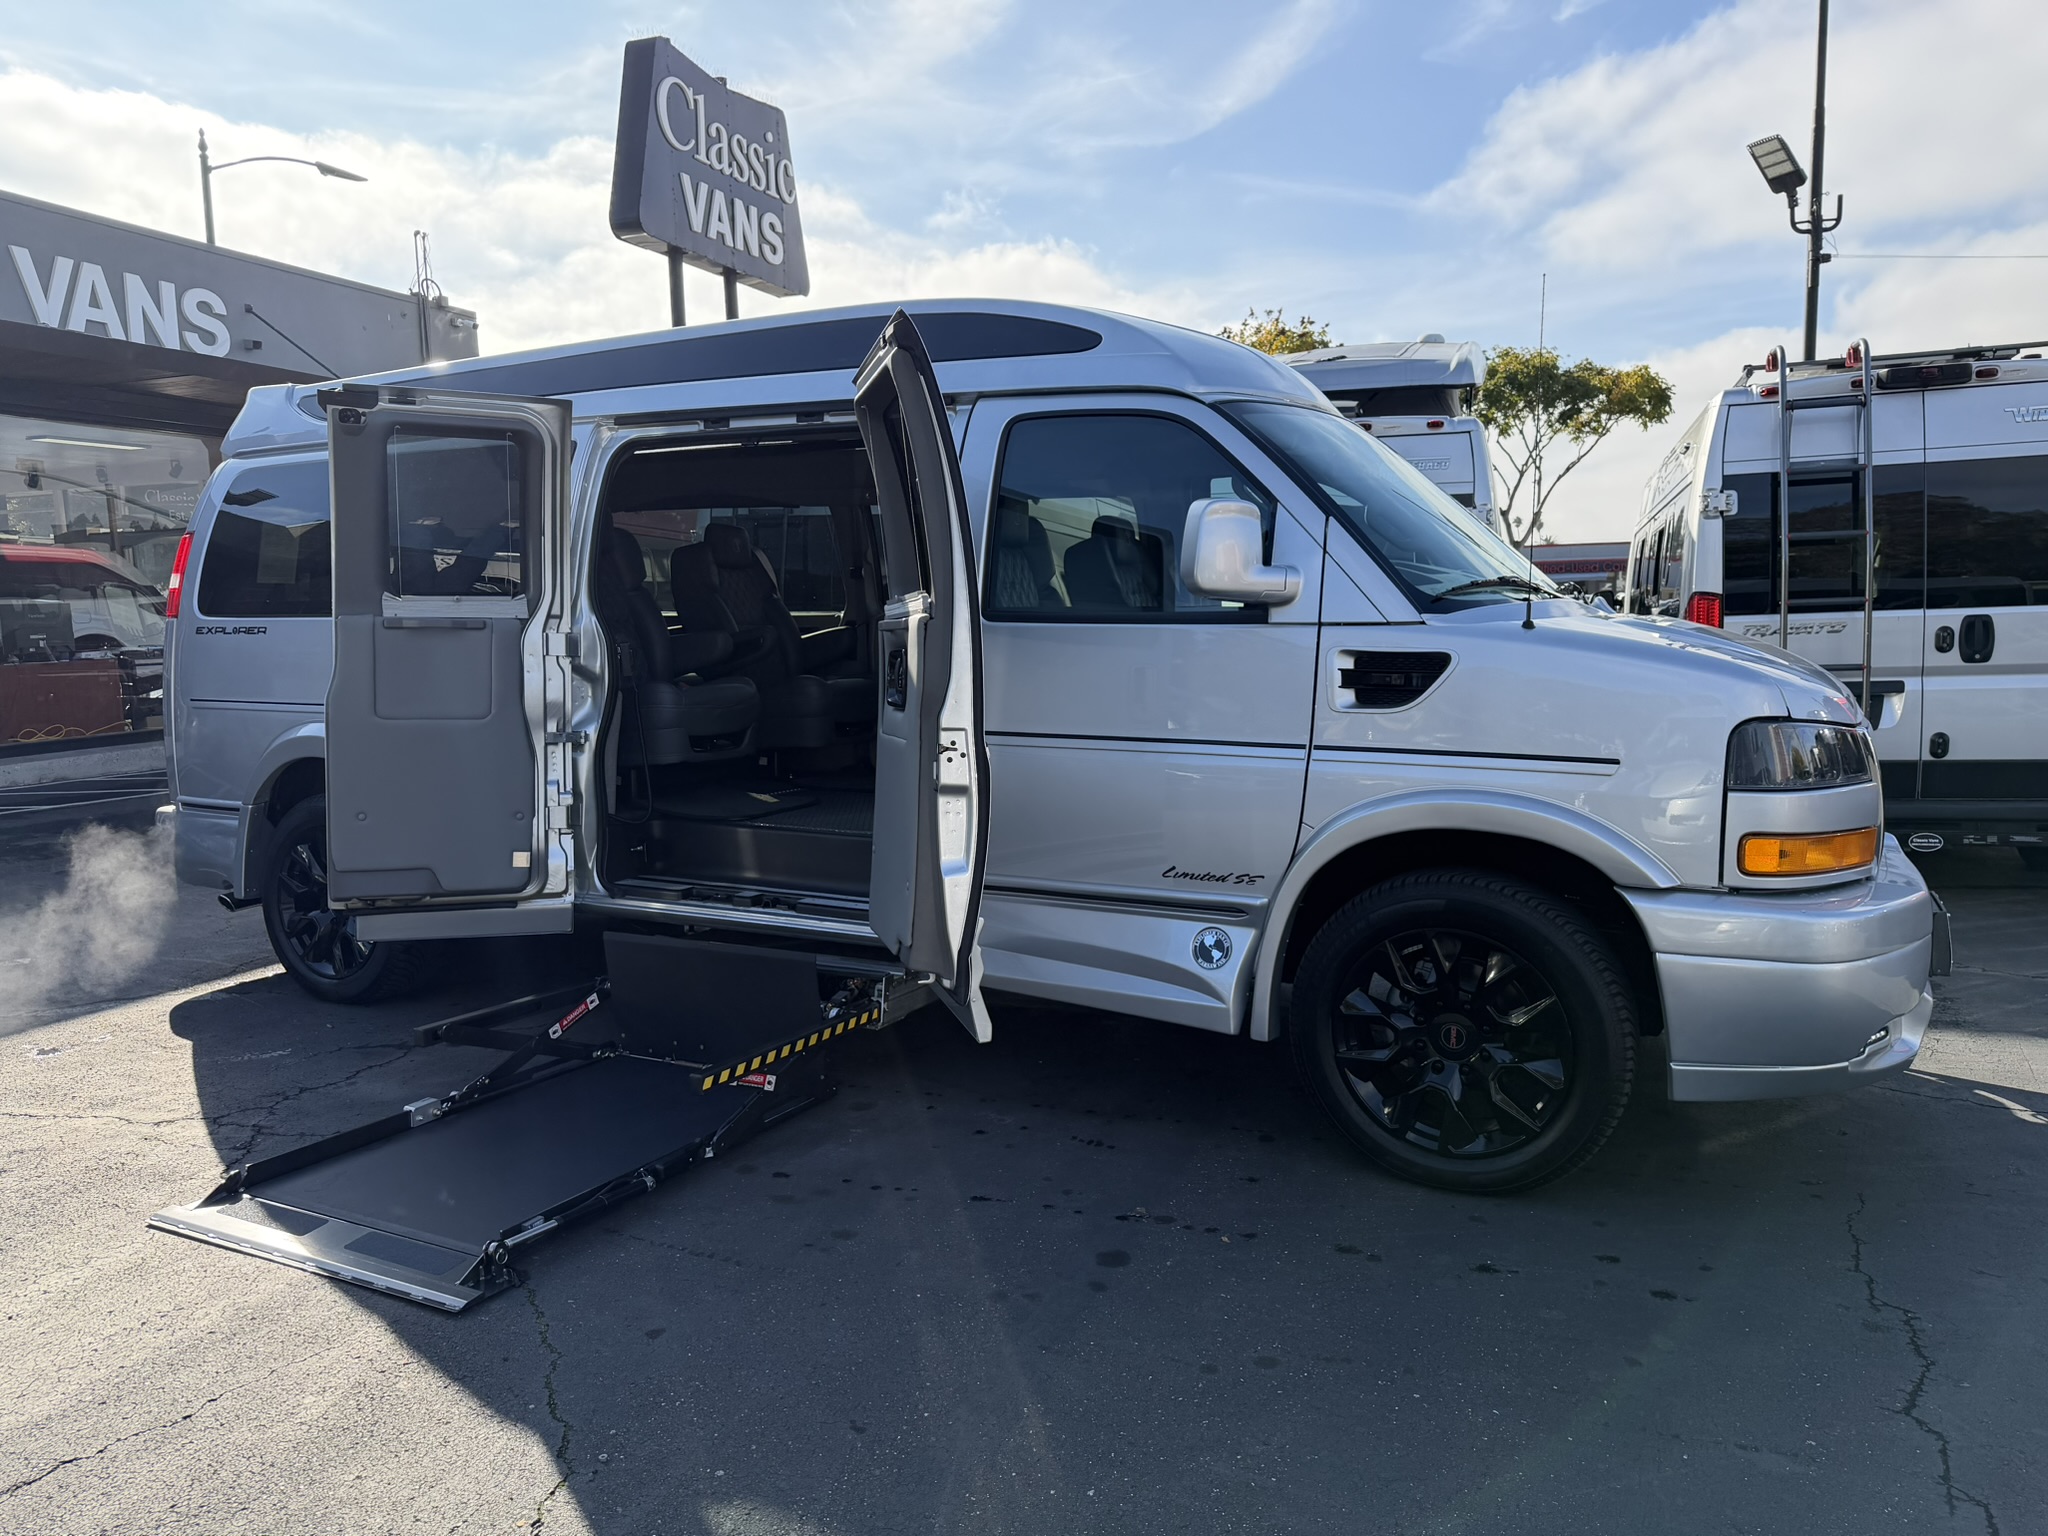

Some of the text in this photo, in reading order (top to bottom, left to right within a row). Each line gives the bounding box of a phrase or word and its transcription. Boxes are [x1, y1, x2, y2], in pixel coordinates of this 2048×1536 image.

[657, 76, 797, 204] Classic
[679, 172, 785, 265] VANS
[8, 244, 231, 357] VANS
[195, 626, 268, 635] EXPLORER
[1162, 865, 1265, 886] Limited SE
